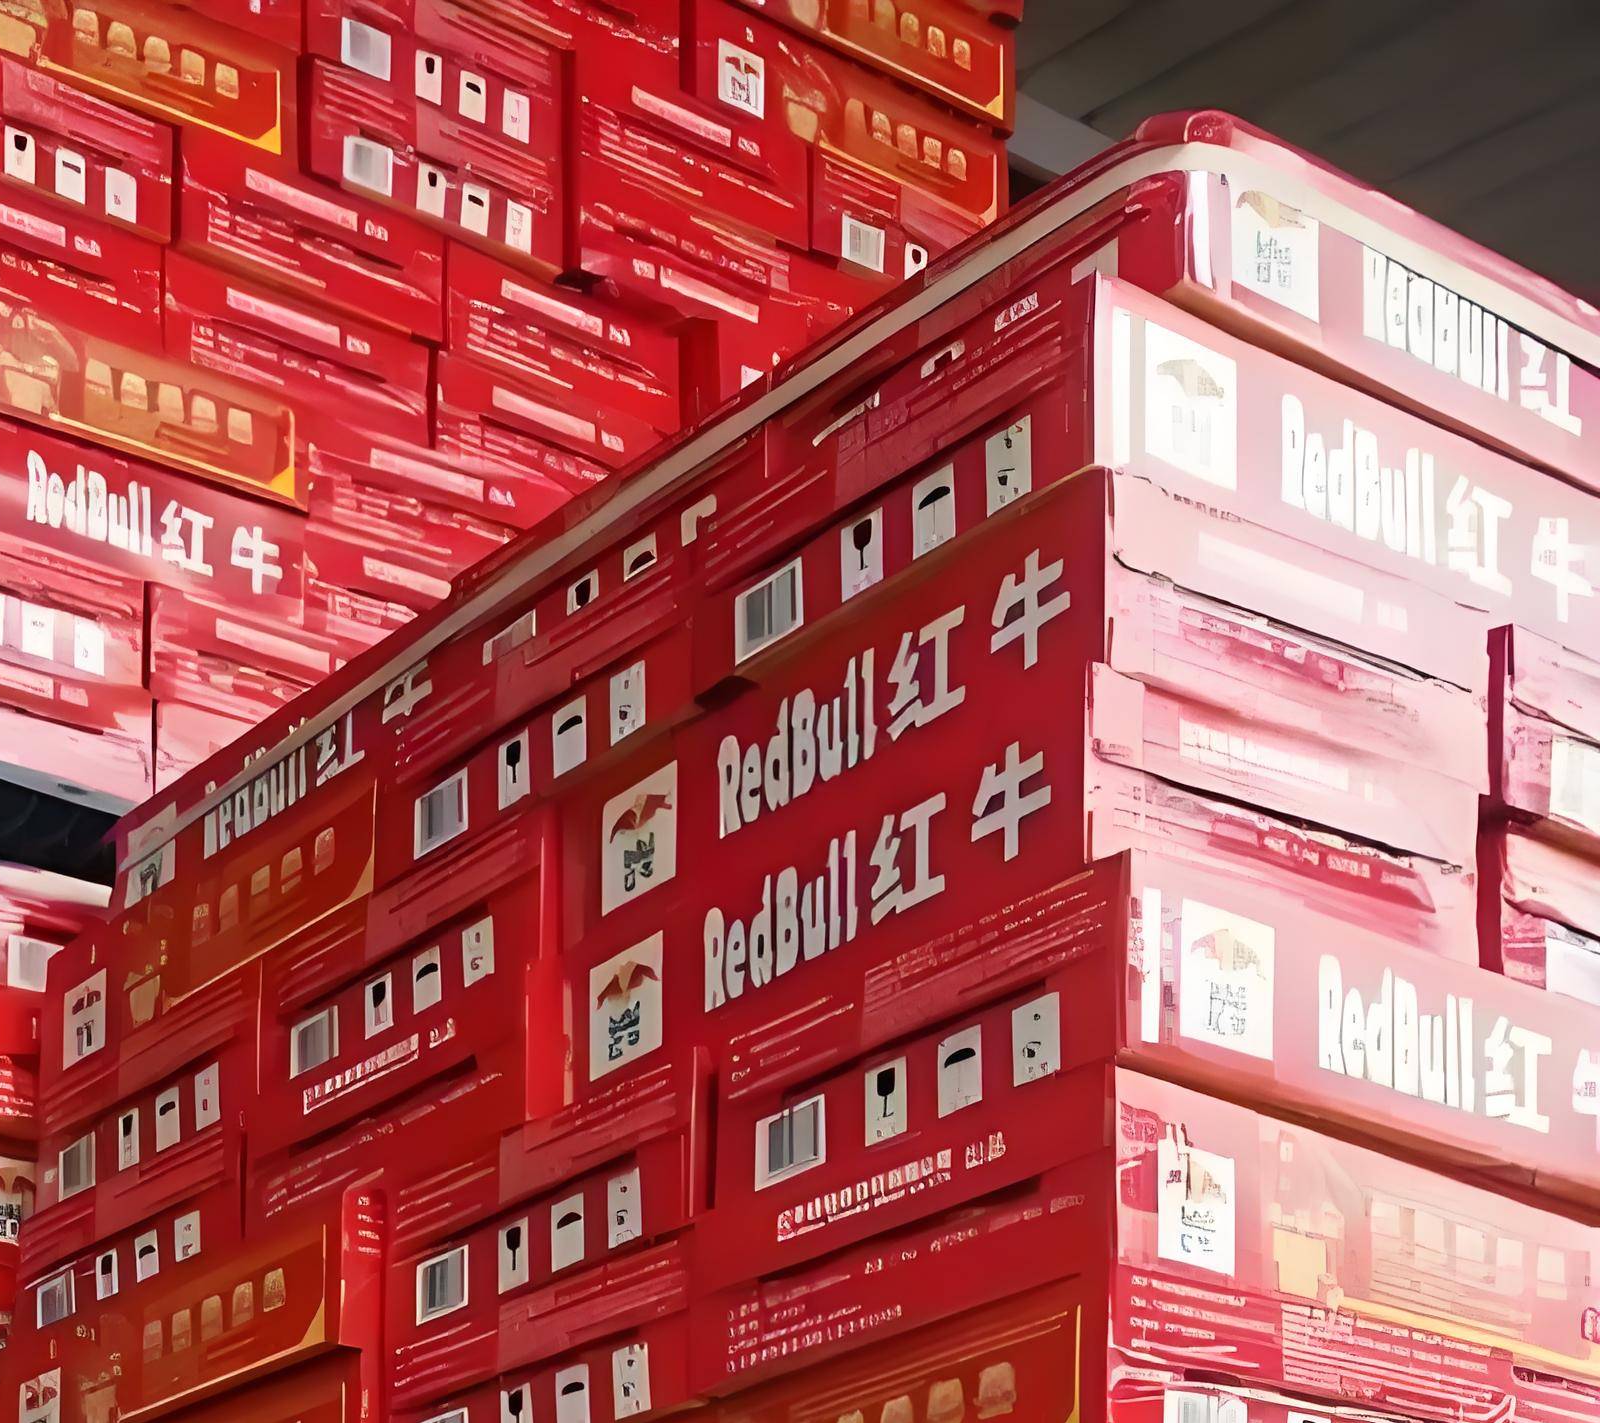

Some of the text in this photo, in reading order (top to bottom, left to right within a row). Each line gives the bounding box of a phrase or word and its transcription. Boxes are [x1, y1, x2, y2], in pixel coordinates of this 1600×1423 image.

[26, 449, 151, 557] RedBull
[717, 547, 1071, 839] RedBull 红牛
[703, 740, 1051, 1012] RedBull 红牛
[1319, 955, 1475, 1112] RedBull
